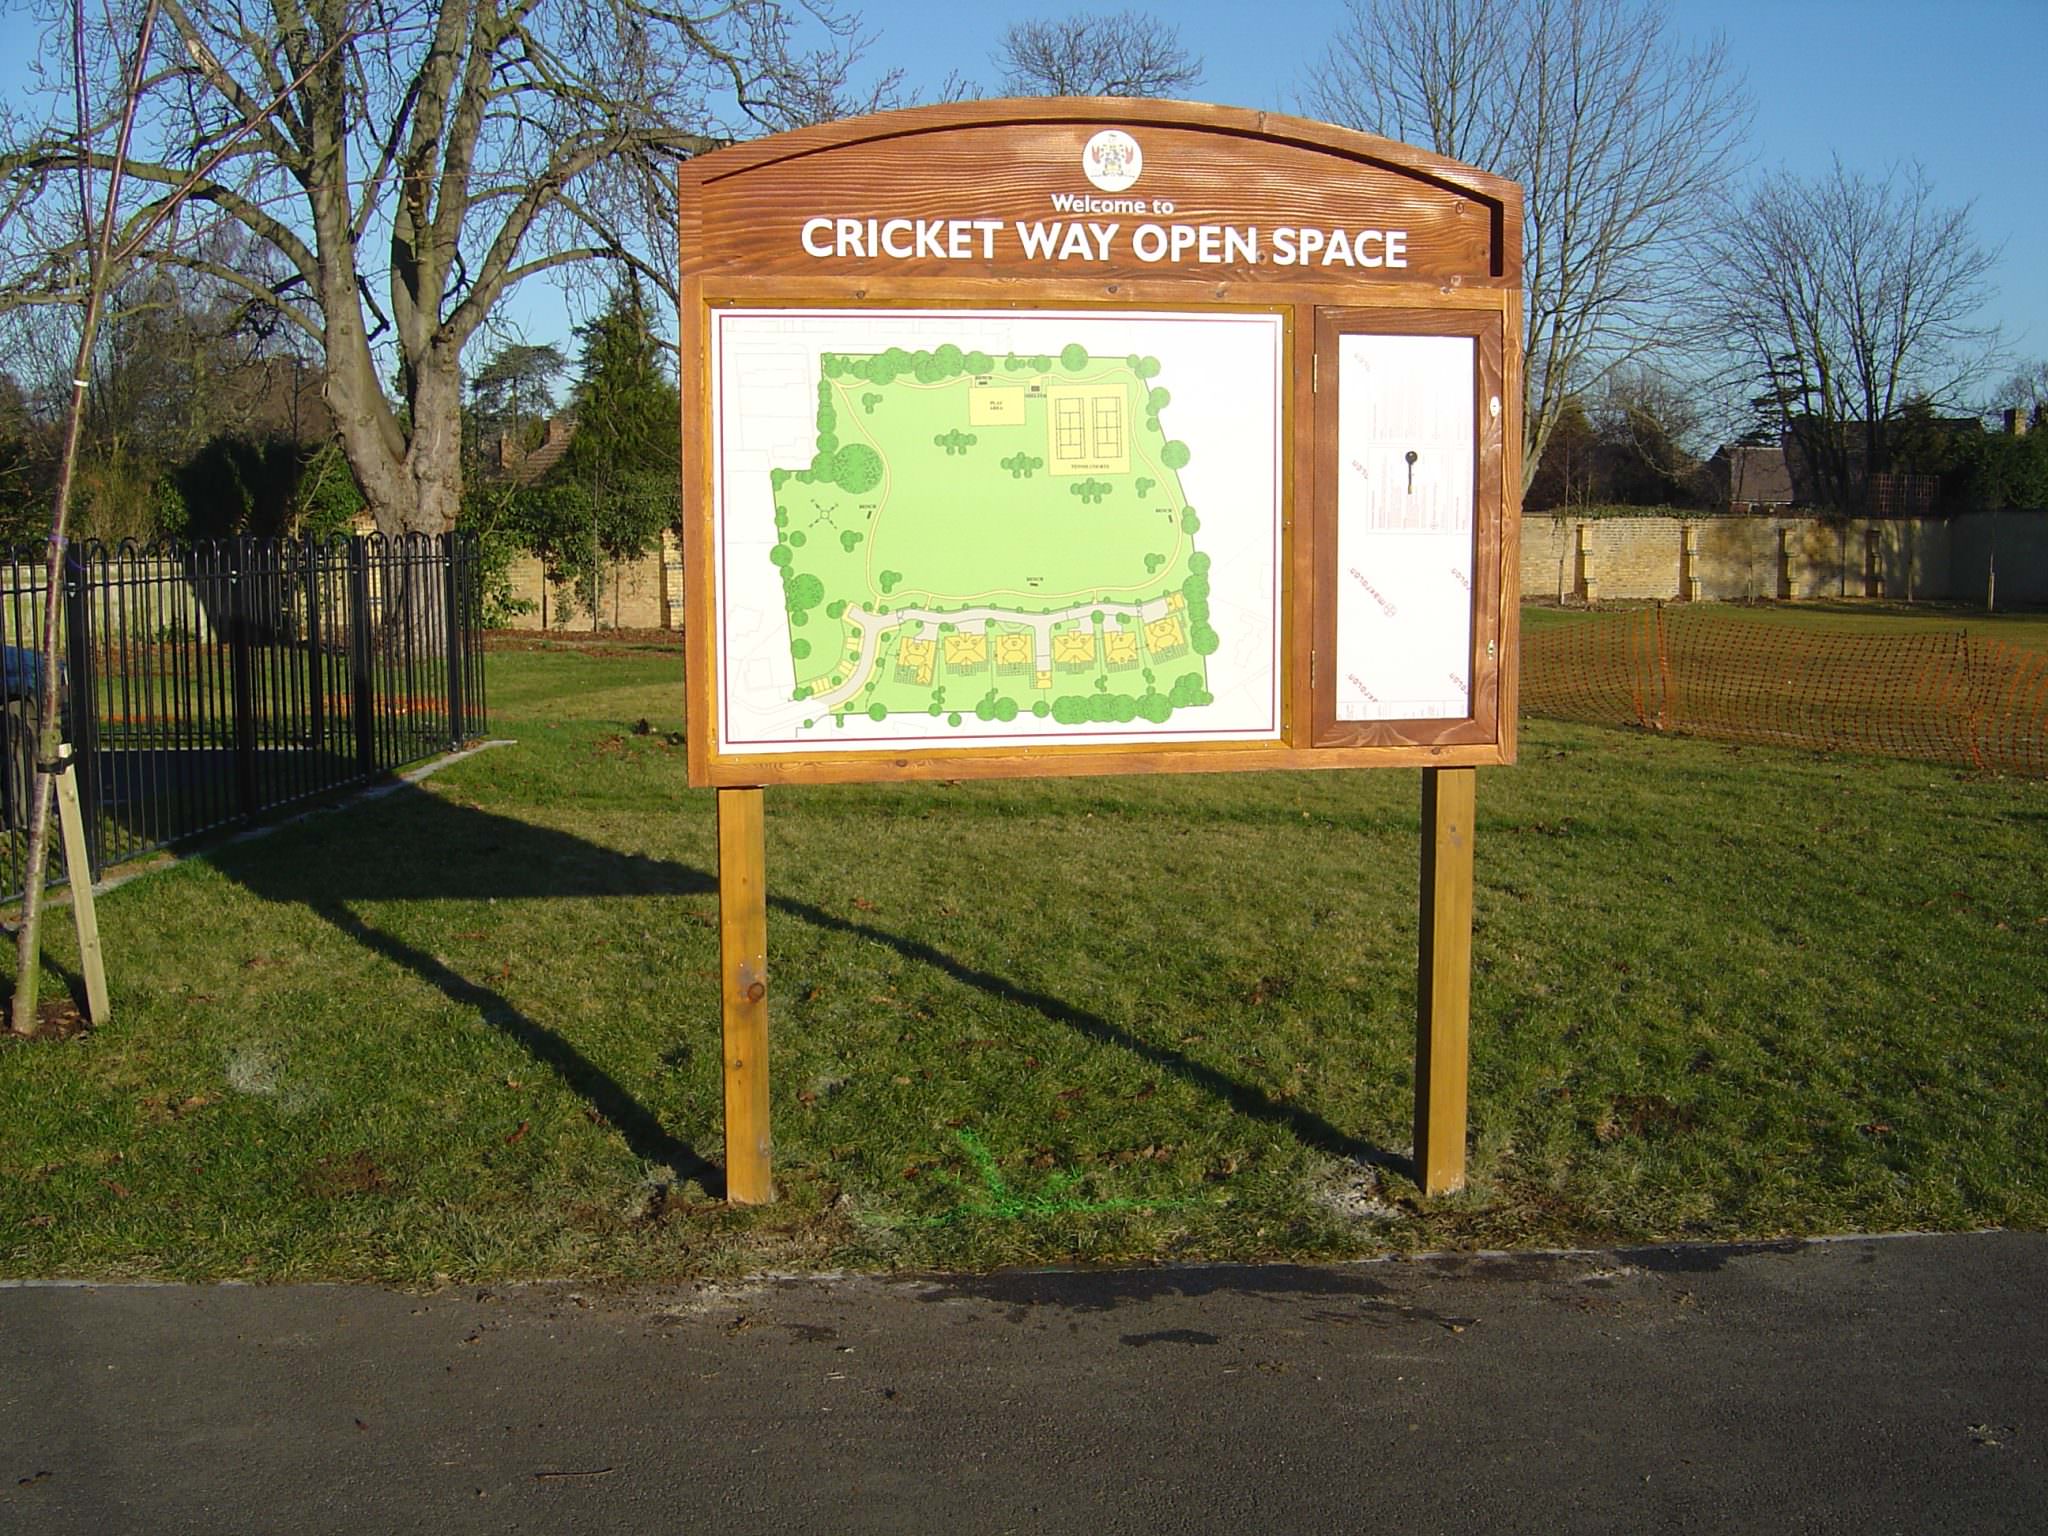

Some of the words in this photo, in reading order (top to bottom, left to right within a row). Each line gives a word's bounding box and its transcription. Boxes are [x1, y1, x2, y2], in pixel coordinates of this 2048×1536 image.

[1050, 193, 1147, 215] Welcome
[1152, 199, 1175, 215] to
[801, 217, 1004, 259] CRICKET
[1015, 221, 1120, 261] WAY
[1132, 223, 1261, 264] OPEN
[1270, 226, 1408, 268] SPACE
